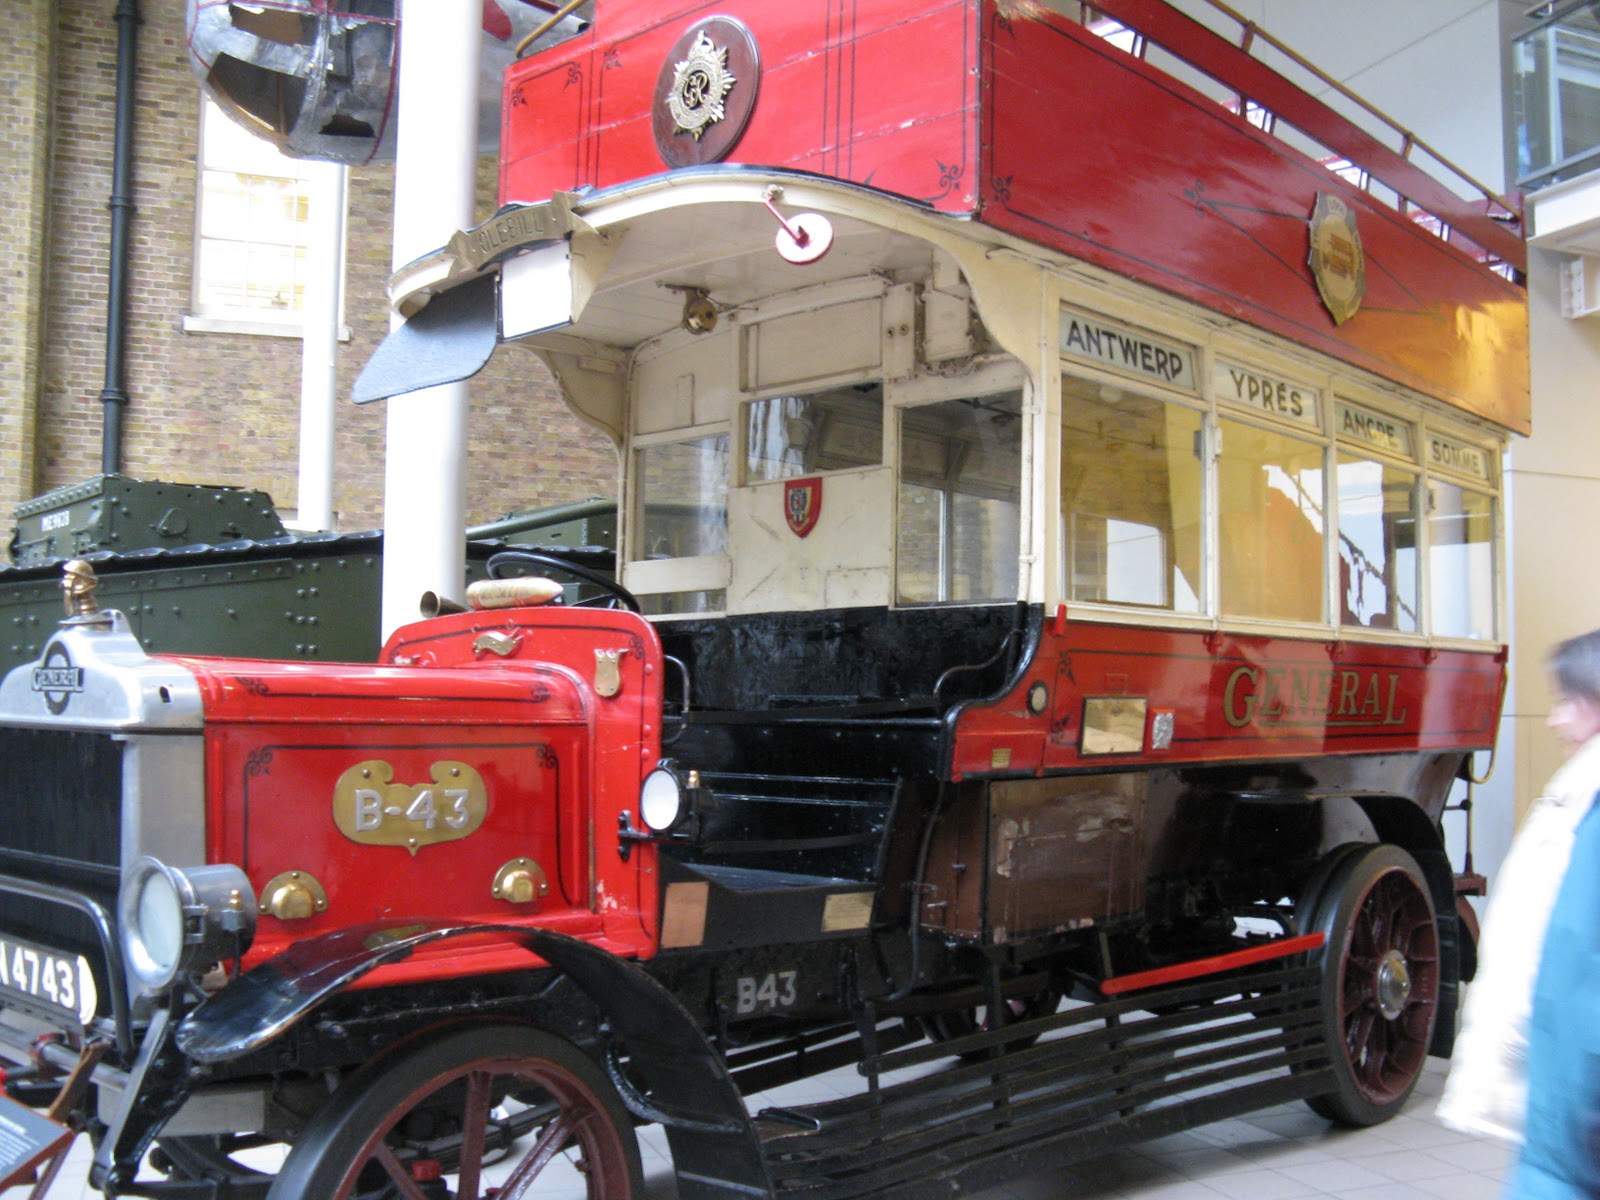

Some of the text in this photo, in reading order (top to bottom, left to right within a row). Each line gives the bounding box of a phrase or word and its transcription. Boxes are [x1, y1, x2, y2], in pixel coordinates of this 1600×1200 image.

[1066, 320, 1183, 381] ANTWERP
[1432, 439, 1482, 475] SOMME
[32, 667, 84, 693] GENERAL
[1222, 666, 1407, 729] GENERAL
[355, 789, 470, 832] B-43
[737, 970, 797, 1014] B43
